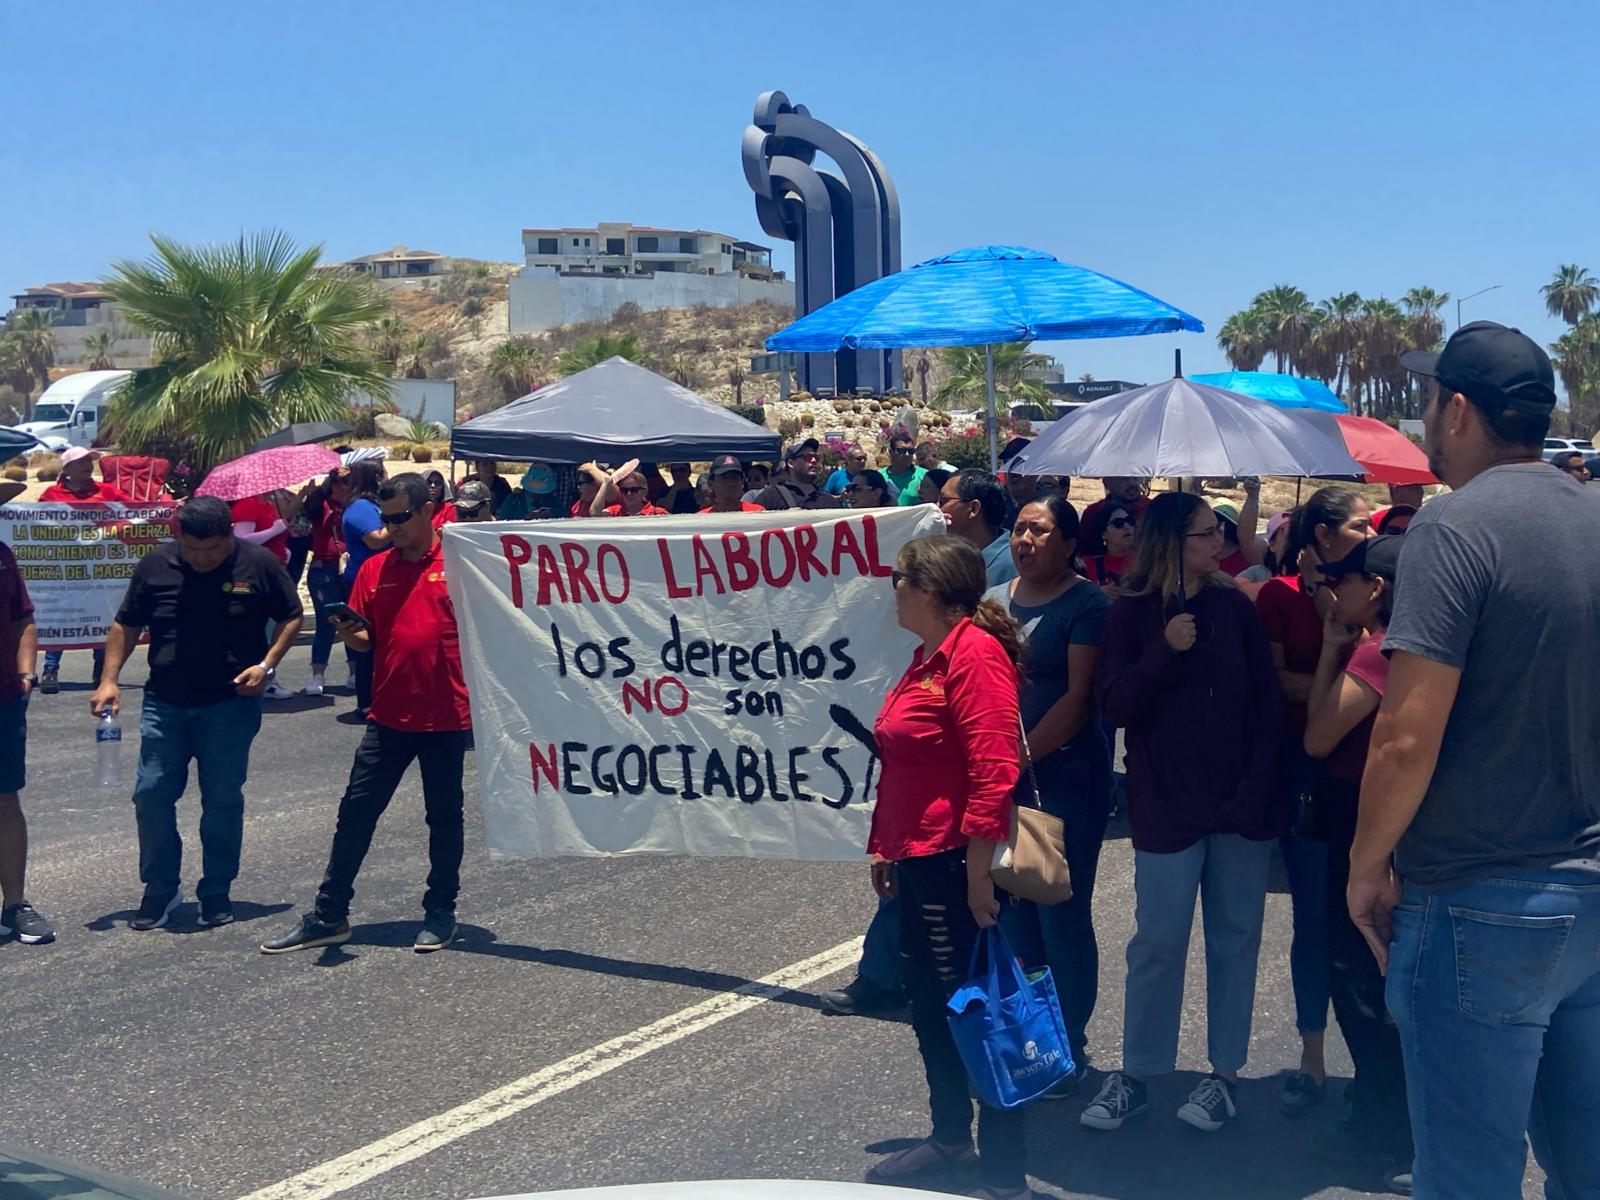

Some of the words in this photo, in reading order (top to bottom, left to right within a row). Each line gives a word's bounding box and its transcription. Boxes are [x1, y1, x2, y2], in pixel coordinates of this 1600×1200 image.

[0, 510, 68, 520] MOVIMIENTO
[70, 510, 123, 520] SINDICAL
[13, 525, 28, 540] LA
[31, 525, 78, 540] UNIDAD
[81, 525, 99, 540] ES
[102, 525, 118, 539] LA
[108, 544, 126, 559] ES
[500, 534, 631, 608] PARO
[657, 515, 893, 600] LABORAL
[65, 565, 90, 580] DEL
[93, 563, 136, 579] MAGIS
[63, 625, 90, 637] ESTÁ
[551, 622, 637, 678] los
[661, 614, 857, 682] derechos
[622, 675, 689, 717] NO
[725, 688, 784, 717] son
